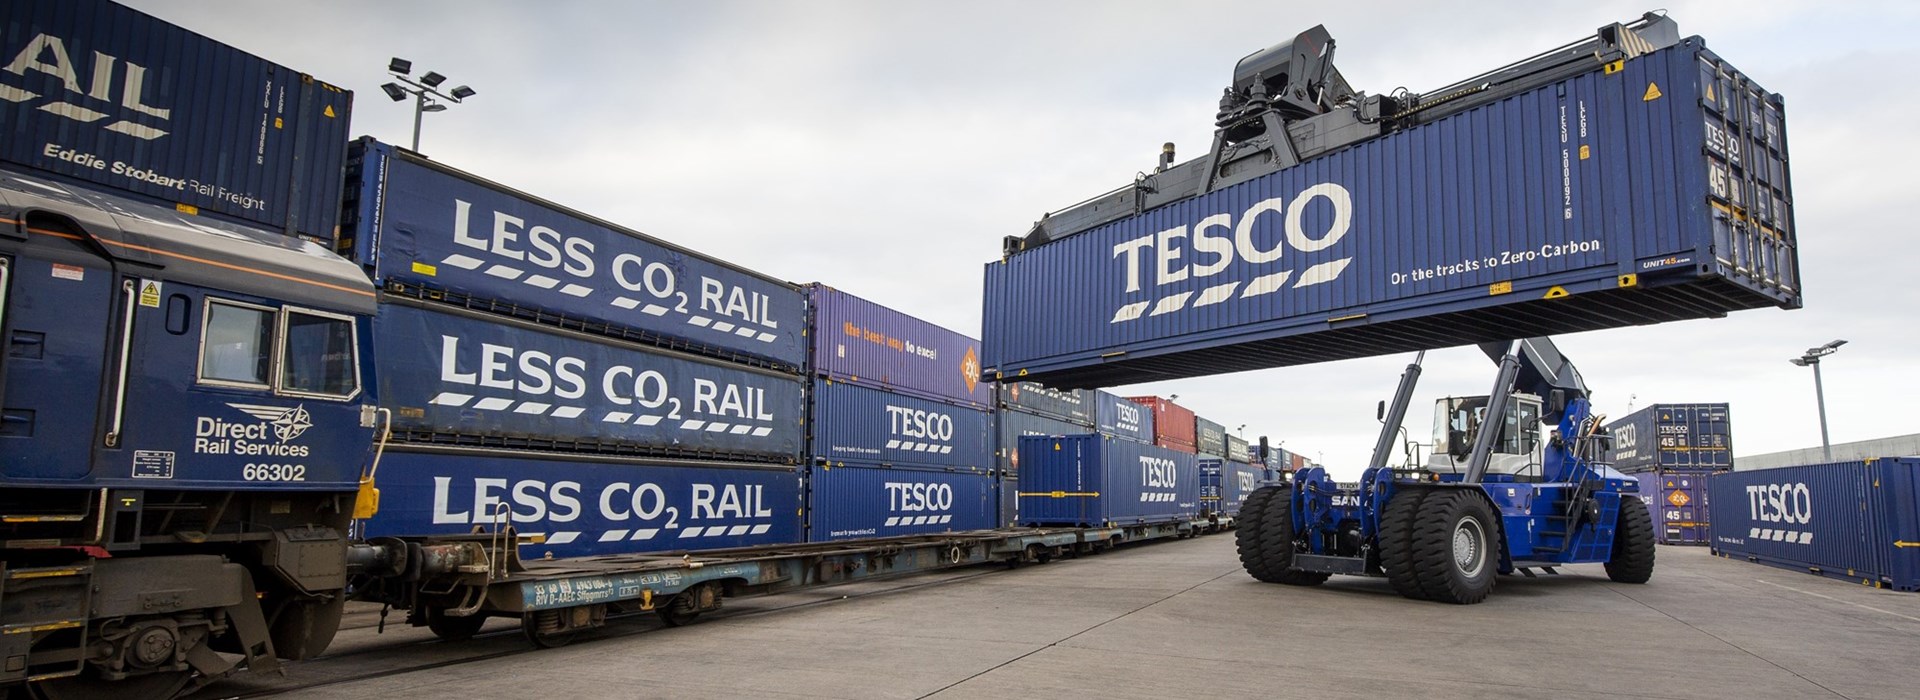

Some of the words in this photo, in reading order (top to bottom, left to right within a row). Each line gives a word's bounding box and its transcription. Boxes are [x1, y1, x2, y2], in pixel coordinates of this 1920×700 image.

[1560, 105, 1568, 143] TESU
[43, 143, 106, 172] Eddie
[111, 161, 186, 191] Stobart
[189, 180, 214, 198] Rail
[218, 187, 265, 211] Freight
[1563, 149, 1571, 206] 500092
[1710, 163, 1727, 199] 45
[1565, 208, 1573, 219] 6
[1113, 183, 1353, 292] TESCO
[453, 199, 595, 278] LESS
[612, 253, 688, 314] CO2
[701, 276, 778, 328] RAIL
[1411, 267, 1433, 281] the
[1436, 260, 1479, 278] tracks
[1484, 256, 1498, 269] to
[1500, 239, 1600, 266] Zero-Carbon
[1643, 257, 1690, 269] UNIT45.com
[844, 321, 860, 337] the
[863, 327, 885, 345] best
[886, 336, 904, 353] way
[905, 340, 915, 354] to
[916, 346, 937, 361] excel
[440, 335, 587, 400] LESS
[602, 365, 681, 420] CO2
[693, 378, 773, 421] RAIL
[196, 416, 267, 440] Direct
[886, 405, 953, 441] TESCO
[1115, 402, 1139, 425] TESCO
[194, 438, 231, 455] Rail
[234, 440, 309, 457] Services
[1614, 423, 1637, 448] TESCO
[1661, 437, 1675, 447] 45
[242, 463, 305, 481] 66302
[1139, 456, 1177, 489] TESCO
[432, 476, 581, 524] LESS
[599, 482, 679, 530] CO2
[690, 484, 771, 520] RAIL
[884, 482, 952, 512] TESCO
[1746, 482, 1811, 525] TESCO
[1666, 510, 1681, 521] 45
